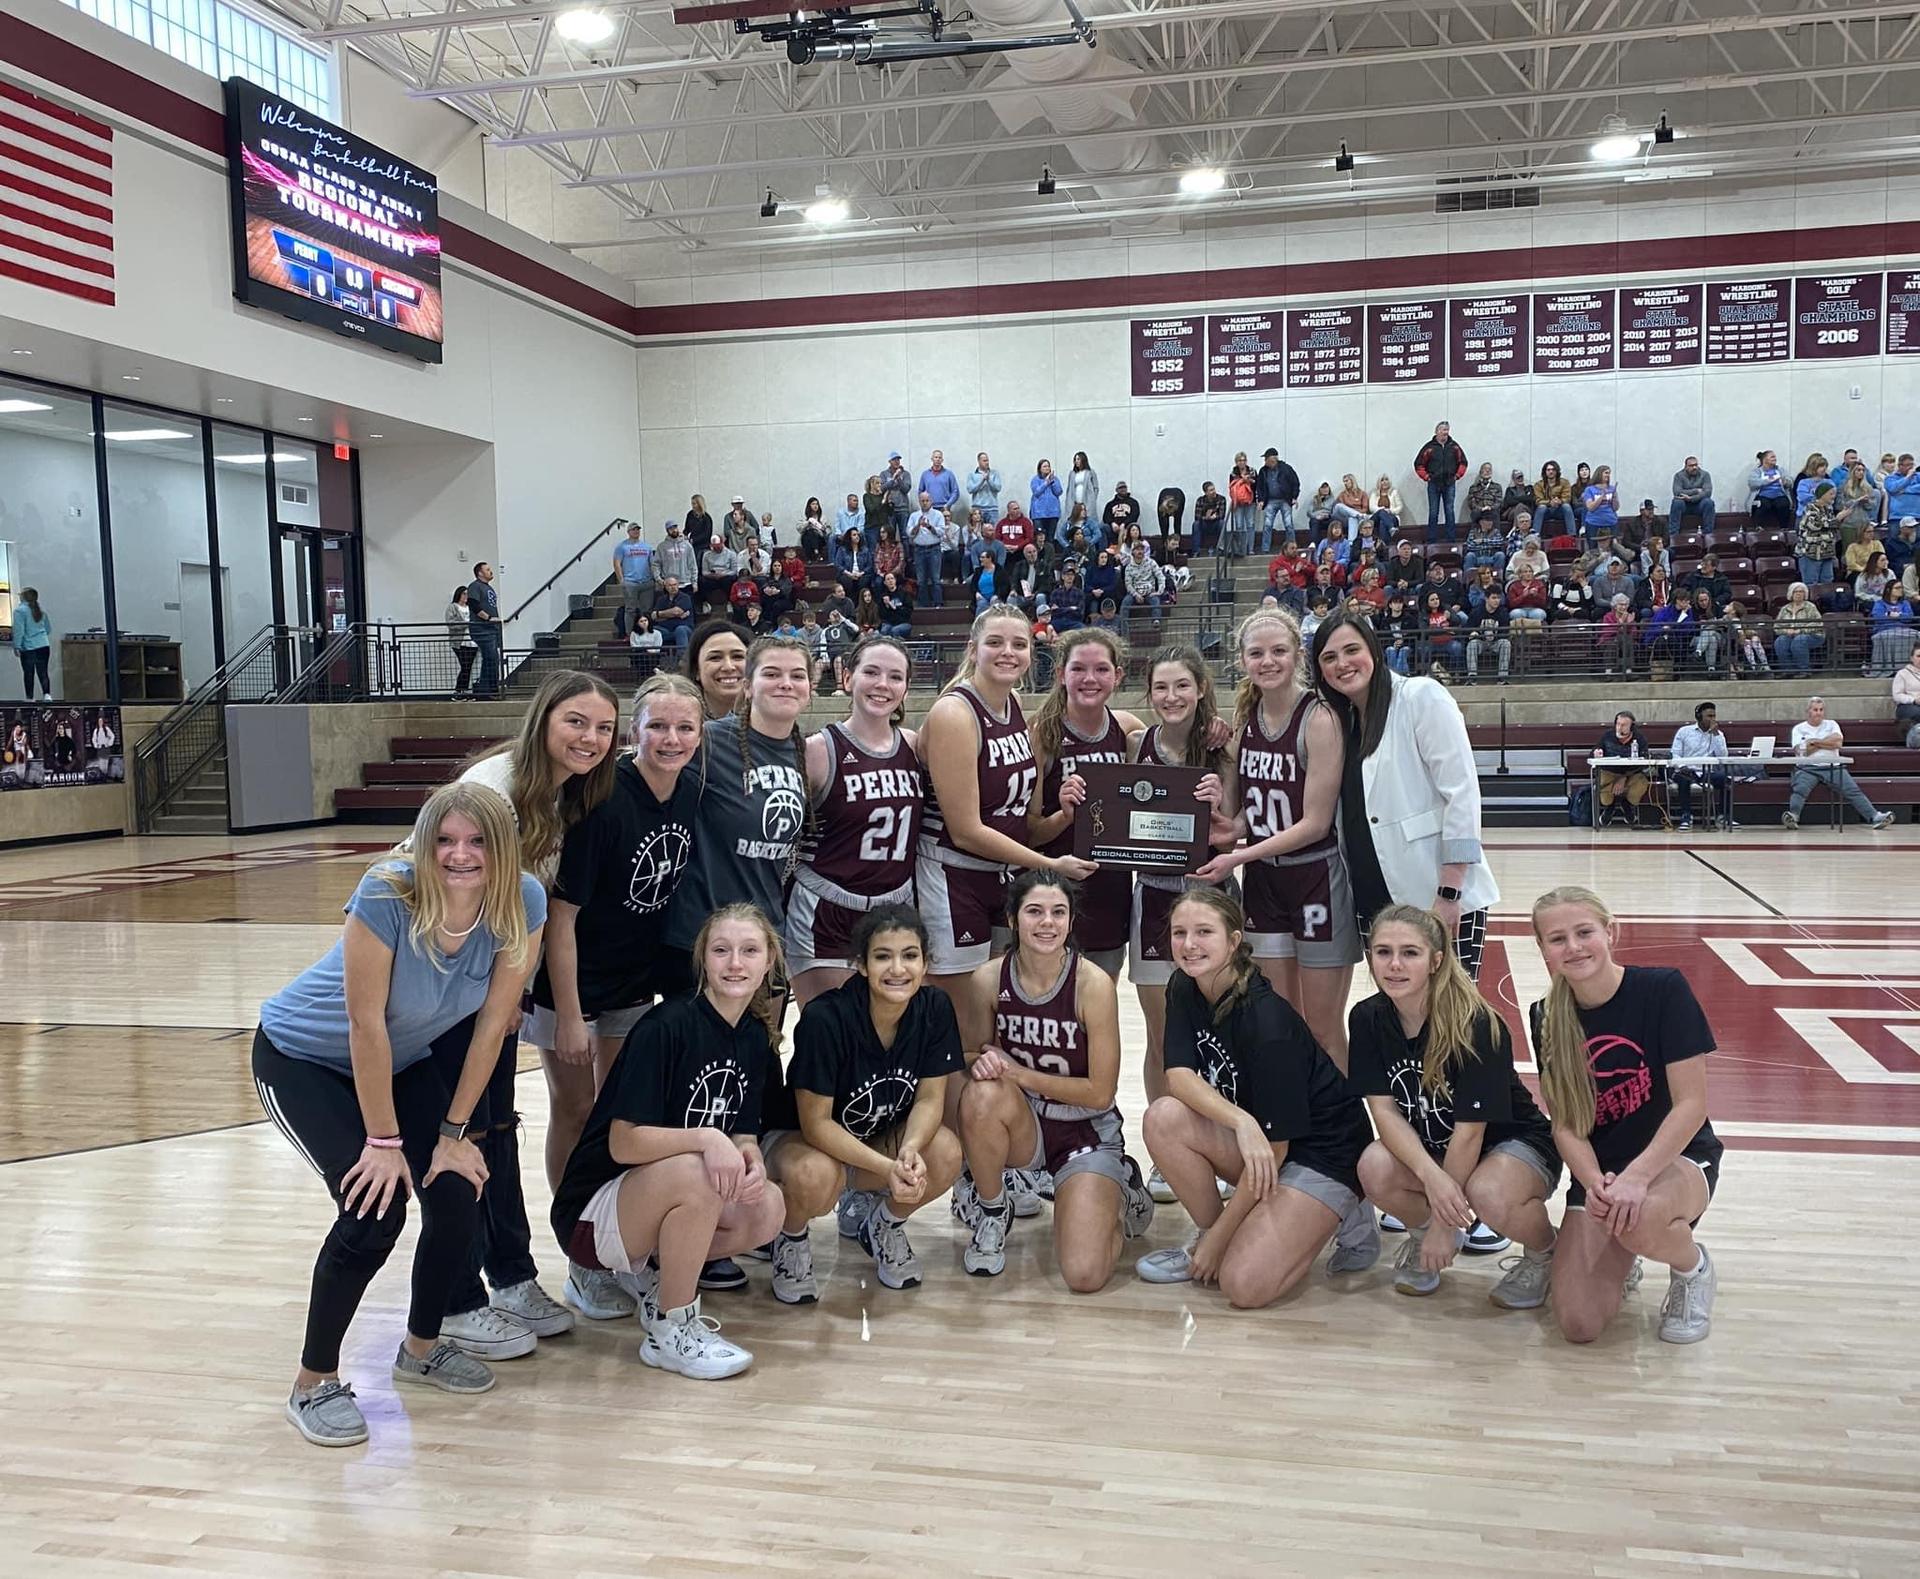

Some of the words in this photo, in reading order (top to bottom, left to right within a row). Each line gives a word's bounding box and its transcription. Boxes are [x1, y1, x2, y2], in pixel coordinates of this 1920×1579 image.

[261, 102, 348, 145] Welcome
[311, 139, 400, 181] Basketball
[313, 163, 356, 191] CLASS
[359, 185, 377, 201] 3A
[381, 195, 414, 217] AREA
[298, 171, 399, 230] REGIONAL
[277, 185, 415, 257] TOURNAMENT
[1821, 278, 1857, 286] MAROONS
[1644, 289, 1678, 297] MAROONS
[1731, 284, 1767, 292] MAROONS
[1827, 286, 1851, 294] GOLF
[1633, 295, 1689, 306] WRESTLING
[1720, 289, 1778, 301] WRESTLING
[1390, 305, 1422, 313] MAROONS
[1463, 305, 1517, 316] WRESTLING
[1547, 300, 1602, 311] WRESTLING
[1719, 305, 1746, 315] DUAL
[1747, 303, 1778, 313] STATE
[1818, 300, 1859, 312] STATE
[1309, 311, 1341, 319] MAROONS
[1380, 311, 1433, 322] WRESTLING
[1559, 315, 1589, 324] STATE
[1646, 309, 1676, 319] STATE
[1720, 312, 1777, 323] CHAMPIONS
[1800, 309, 1876, 324] CHAMPIONS
[1220, 321, 1271, 332] WRESTLING
[1300, 316, 1352, 327] WRESTLING
[1475, 319, 1504, 329] STATE
[1547, 321, 1601, 333] CHAMPIONS
[1633, 317, 1689, 328] CHAMPIONS
[1143, 327, 1193, 337] WRESTLING
[1311, 330, 1339, 339] STATE
[1392, 324, 1421, 334] STATE
[1463, 326, 1516, 338] CHAMPIONS
[1623, 330, 1646, 339] 2010
[1650, 329, 1671, 338] 2011
[1675, 327, 1698, 337] 2013
[1232, 335, 1259, 345] STATE
[1299, 336, 1350, 348] CHAMPIONS
[1380, 332, 1432, 343] CHAMPIONS
[1536, 336, 1559, 344] 2000
[1562, 335, 1585, 343] 2001
[1588, 332, 1611, 342] 2004
[1817, 329, 1859, 344] 2006
[1154, 340, 1181, 349] STATE
[1220, 342, 1271, 353] CHAMPIONS
[1623, 343, 1645, 352] 2014
[1649, 342, 1672, 351] 2017
[1143, 348, 1192, 358] CHAMPIONS
[1289, 350, 1309, 359] 1971
[1314, 349, 1335, 359] 1972
[1339, 347, 1361, 357] 1973
[1536, 347, 1559, 357] 2005
[1587, 344, 1611, 355] 2007
[1210, 355, 1229, 364] 1961
[1235, 354, 1256, 363] 1962
[1259, 352, 1280, 362] 1963
[1151, 359, 1184, 373] 1952
[1289, 362, 1310, 372] 1974
[1314, 361, 1335, 370] 1975
[1210, 367, 1231, 377] 1964
[1289, 374, 1310, 384] 1977
[1151, 379, 1183, 392] 1955
[987, 729, 1034, 768] PERR
[1240, 748, 1296, 782] PERRY
[844, 769, 924, 803] PERRY
[992, 766, 1037, 816] 15
[1119, 786, 1132, 794] 20
[1154, 788, 1167, 796] 23
[1246, 786, 1293, 837] 20
[773, 817, 791, 840] P
[859, 806, 912, 862] 21
[1091, 850, 1132, 859] REGIONAL
[1133, 852, 1188, 861] CONSOLATION
[653, 859, 671, 885] P
[1303, 903, 1328, 937] P
[997, 1013, 1078, 1049] PERRY
[707, 1097, 726, 1126] P
